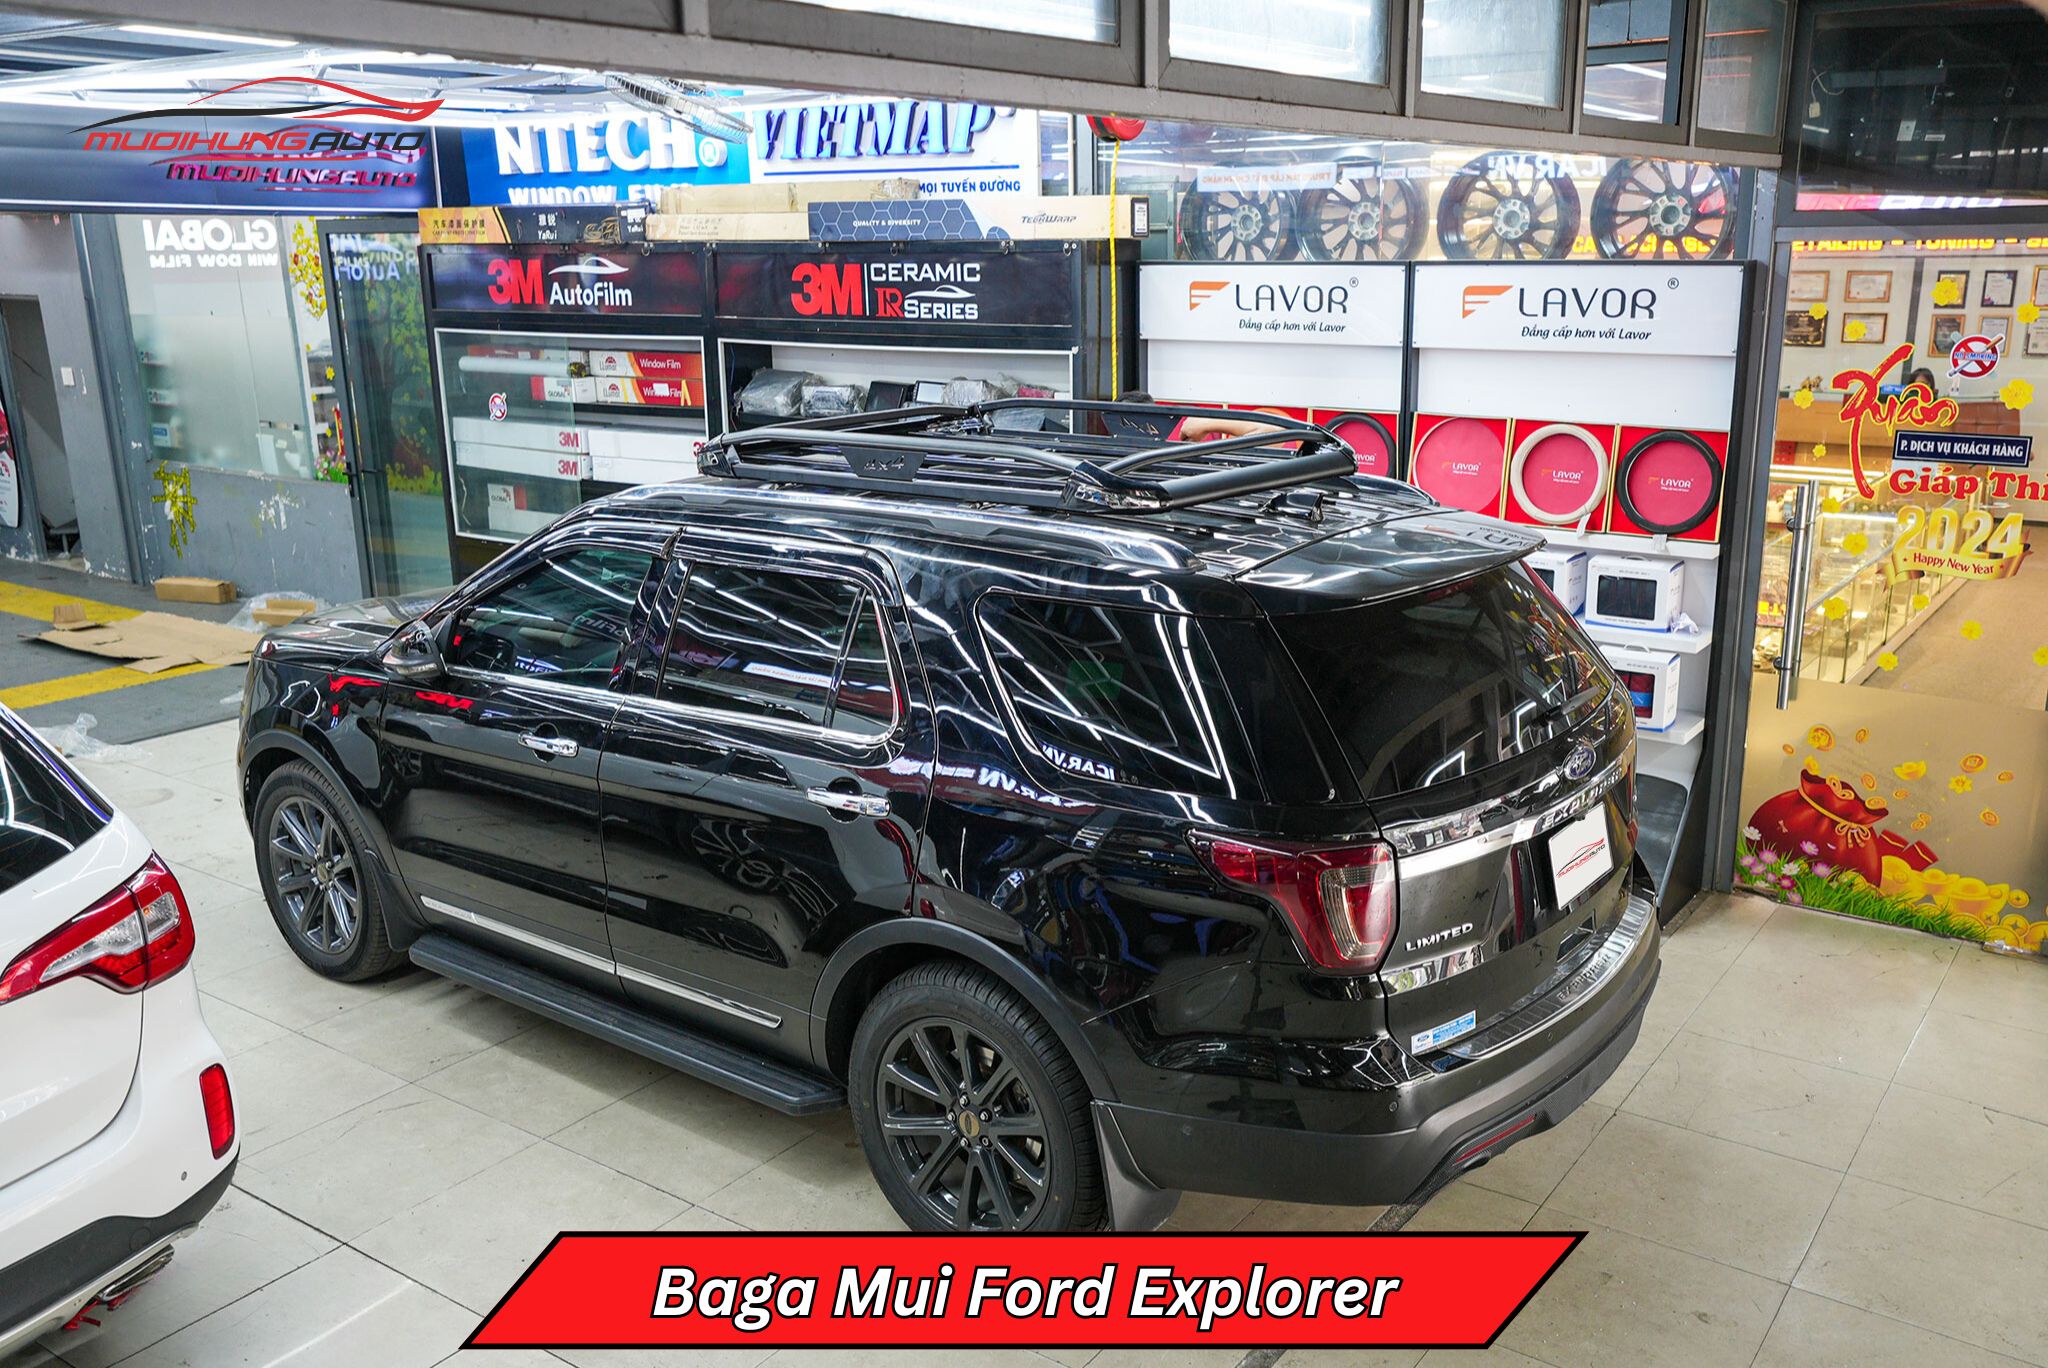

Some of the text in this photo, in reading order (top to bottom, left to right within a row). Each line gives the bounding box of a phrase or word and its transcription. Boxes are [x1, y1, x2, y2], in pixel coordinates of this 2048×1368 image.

[494, 109, 699, 175] NTECH
[941, 177, 976, 193] TUYẾN
[979, 175, 1021, 192] ĐƯỜNG
[852, 219, 880, 227] QUALITY
[887, 218, 921, 226] DIVERSITY
[870, 262, 981, 282] CERAMIC
[487, 258, 633, 306] 3M AutoFilm
[790, 262, 864, 316] 3M
[1235, 283, 1349, 314] LAVOR
[1518, 287, 1658, 320] LAVOR
[1264, 318, 1281, 332] cấp
[1283, 321, 1301, 331] hơn
[1319, 321, 1346, 333] Lavor
[1552, 324, 1573, 340] cấp
[1575, 327, 1596, 338] hơn
[1618, 328, 1652, 340] Lavor
[639, 357, 681, 369] Window Film
[1832, 344, 1959, 499] Xuân
[559, 431, 580, 448] 3M
[1910, 440, 1935, 455] DỊCH
[1936, 441, 1952, 456] VỤ
[1953, 440, 1991, 456] KHÁCH
[1992, 441, 2024, 458] HÀNG
[558, 459, 578, 476] 3M
[1452, 462, 1480, 472] LAVOR
[1552, 470, 1582, 481] LAVOR
[1660, 478, 1692, 489] LAVOR
[1889, 467, 1980, 500] Giáp
[1894, 504, 2025, 562] 2024
[1913, 552, 1995, 575] Happy New Year
[1405, 922, 1474, 951] LIMITED
